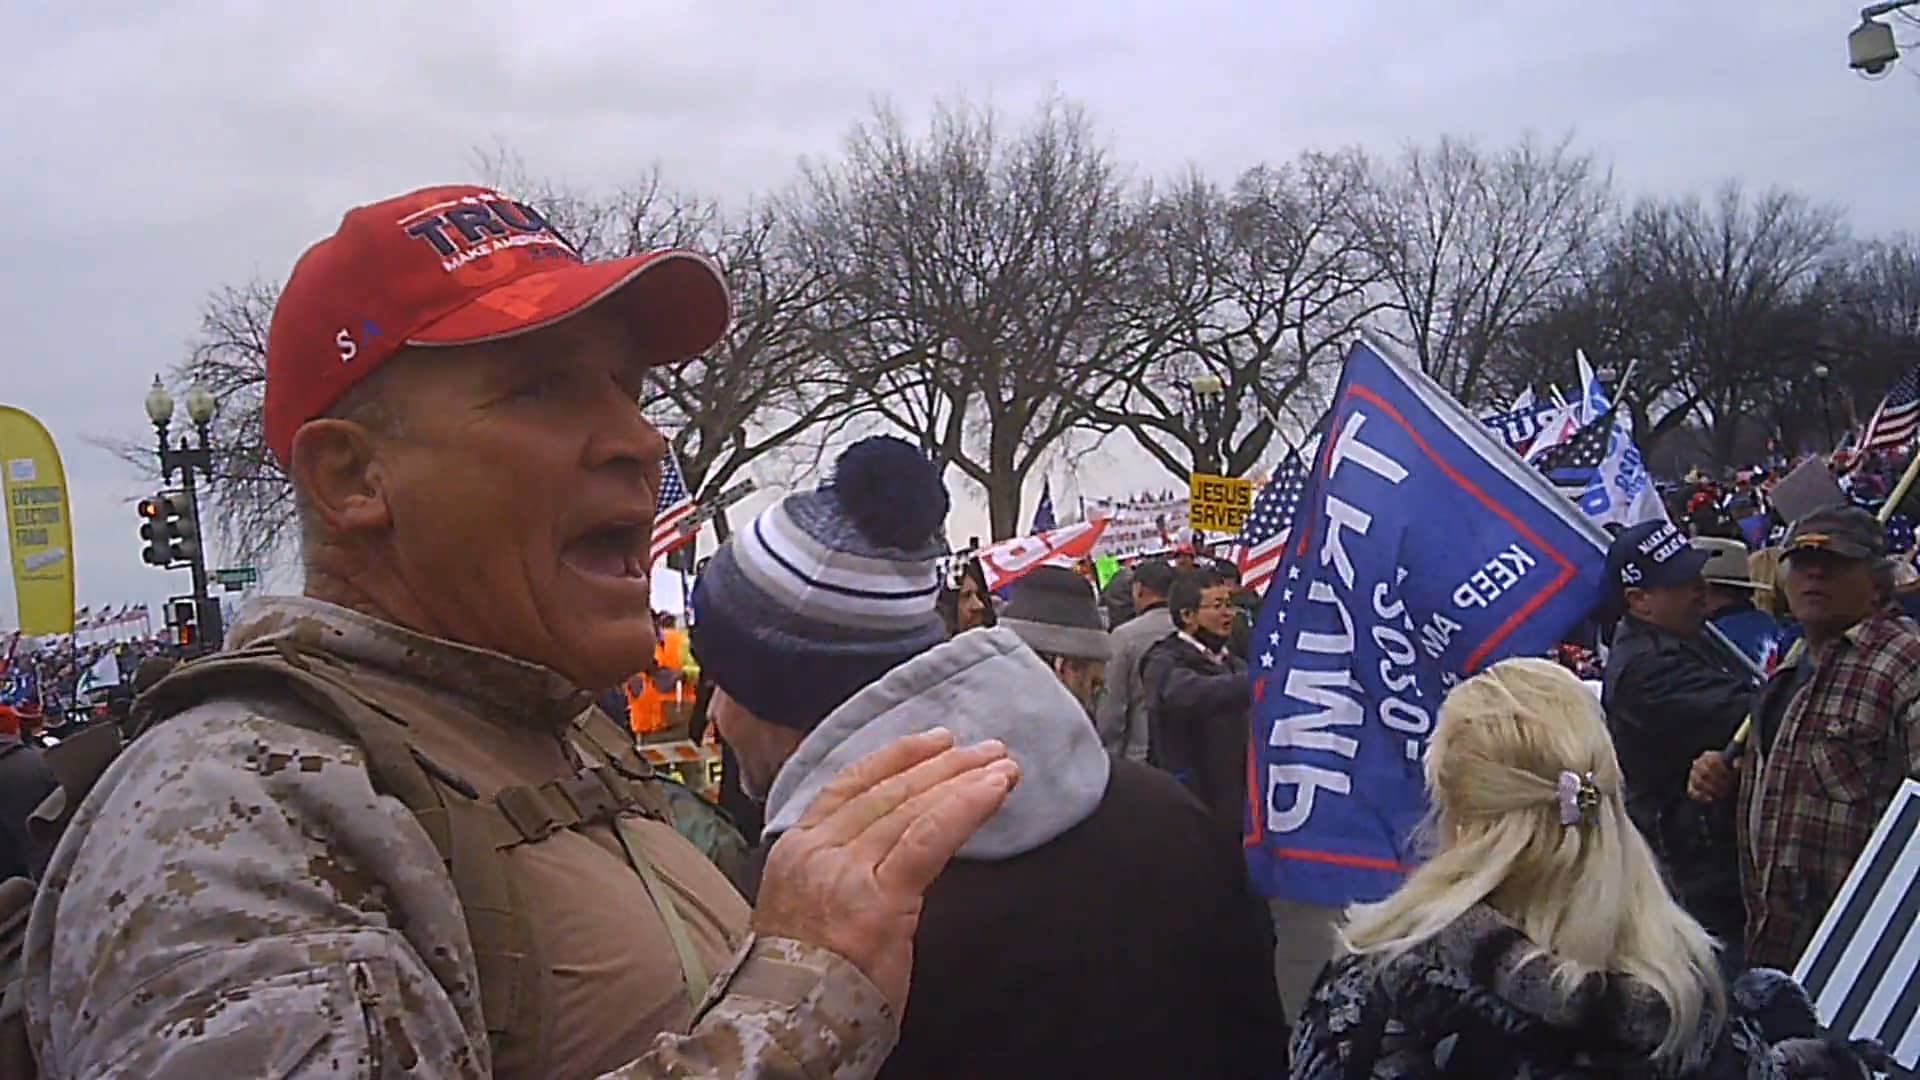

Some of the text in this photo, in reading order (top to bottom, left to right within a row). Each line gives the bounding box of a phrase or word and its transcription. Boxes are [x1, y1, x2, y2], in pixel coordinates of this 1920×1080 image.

[406, 199, 553, 258] TRU
[441, 246, 493, 273] MAKE
[1193, 481, 1249, 506] JESUS
[1620, 562, 1643, 585] 45
